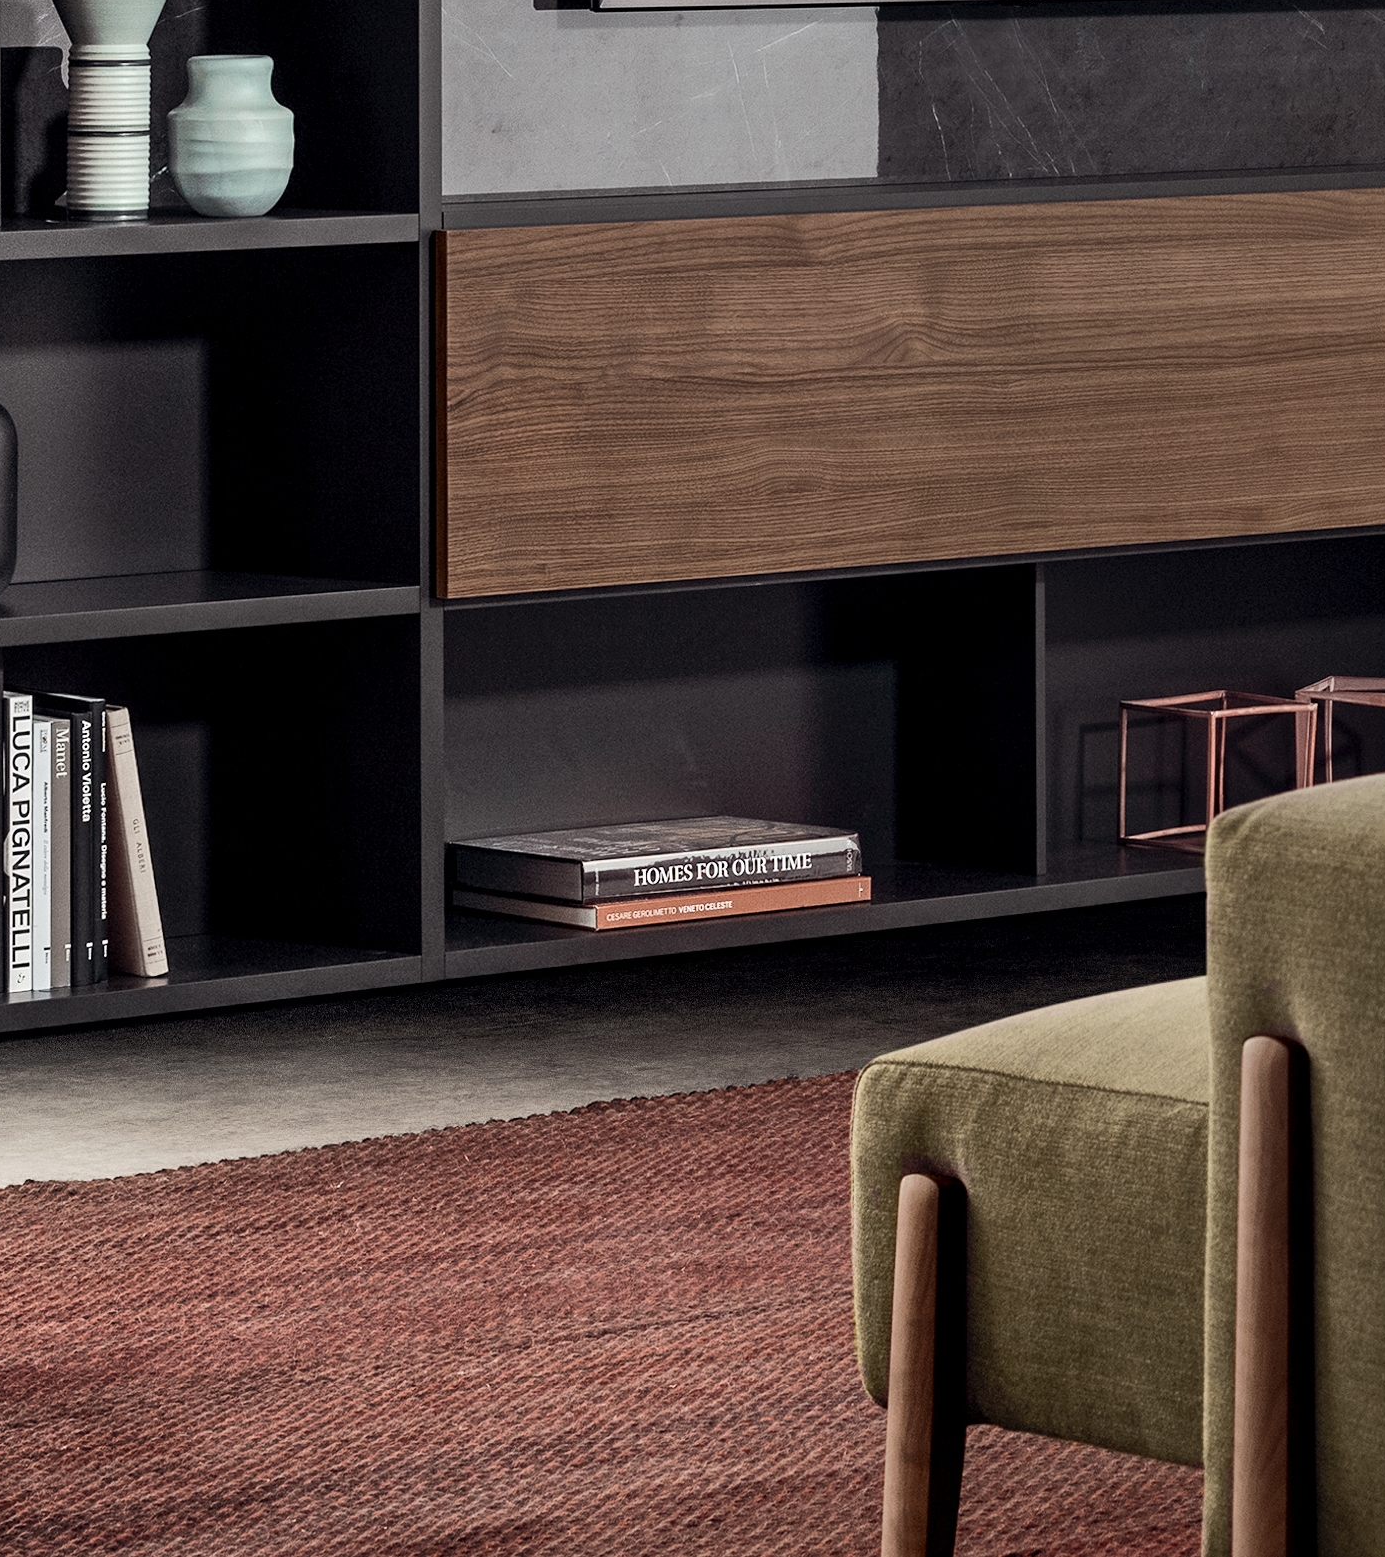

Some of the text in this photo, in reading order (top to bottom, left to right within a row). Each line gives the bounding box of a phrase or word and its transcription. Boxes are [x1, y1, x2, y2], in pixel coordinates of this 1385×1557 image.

[55, 727, 70, 779] Manet
[81, 719, 92, 823] Antonio Violetta
[11, 715, 31, 970] LUCA PIGNATELLI
[99, 844, 107, 879] Disegno
[132, 818, 147, 874] GLI ALBERI
[633, 852, 813, 888] HOMES FOR OUR TIME
[606, 911, 633, 923] CESARE
[678, 903, 705, 914] VENETO
[704, 900, 734, 912] CELESTE
